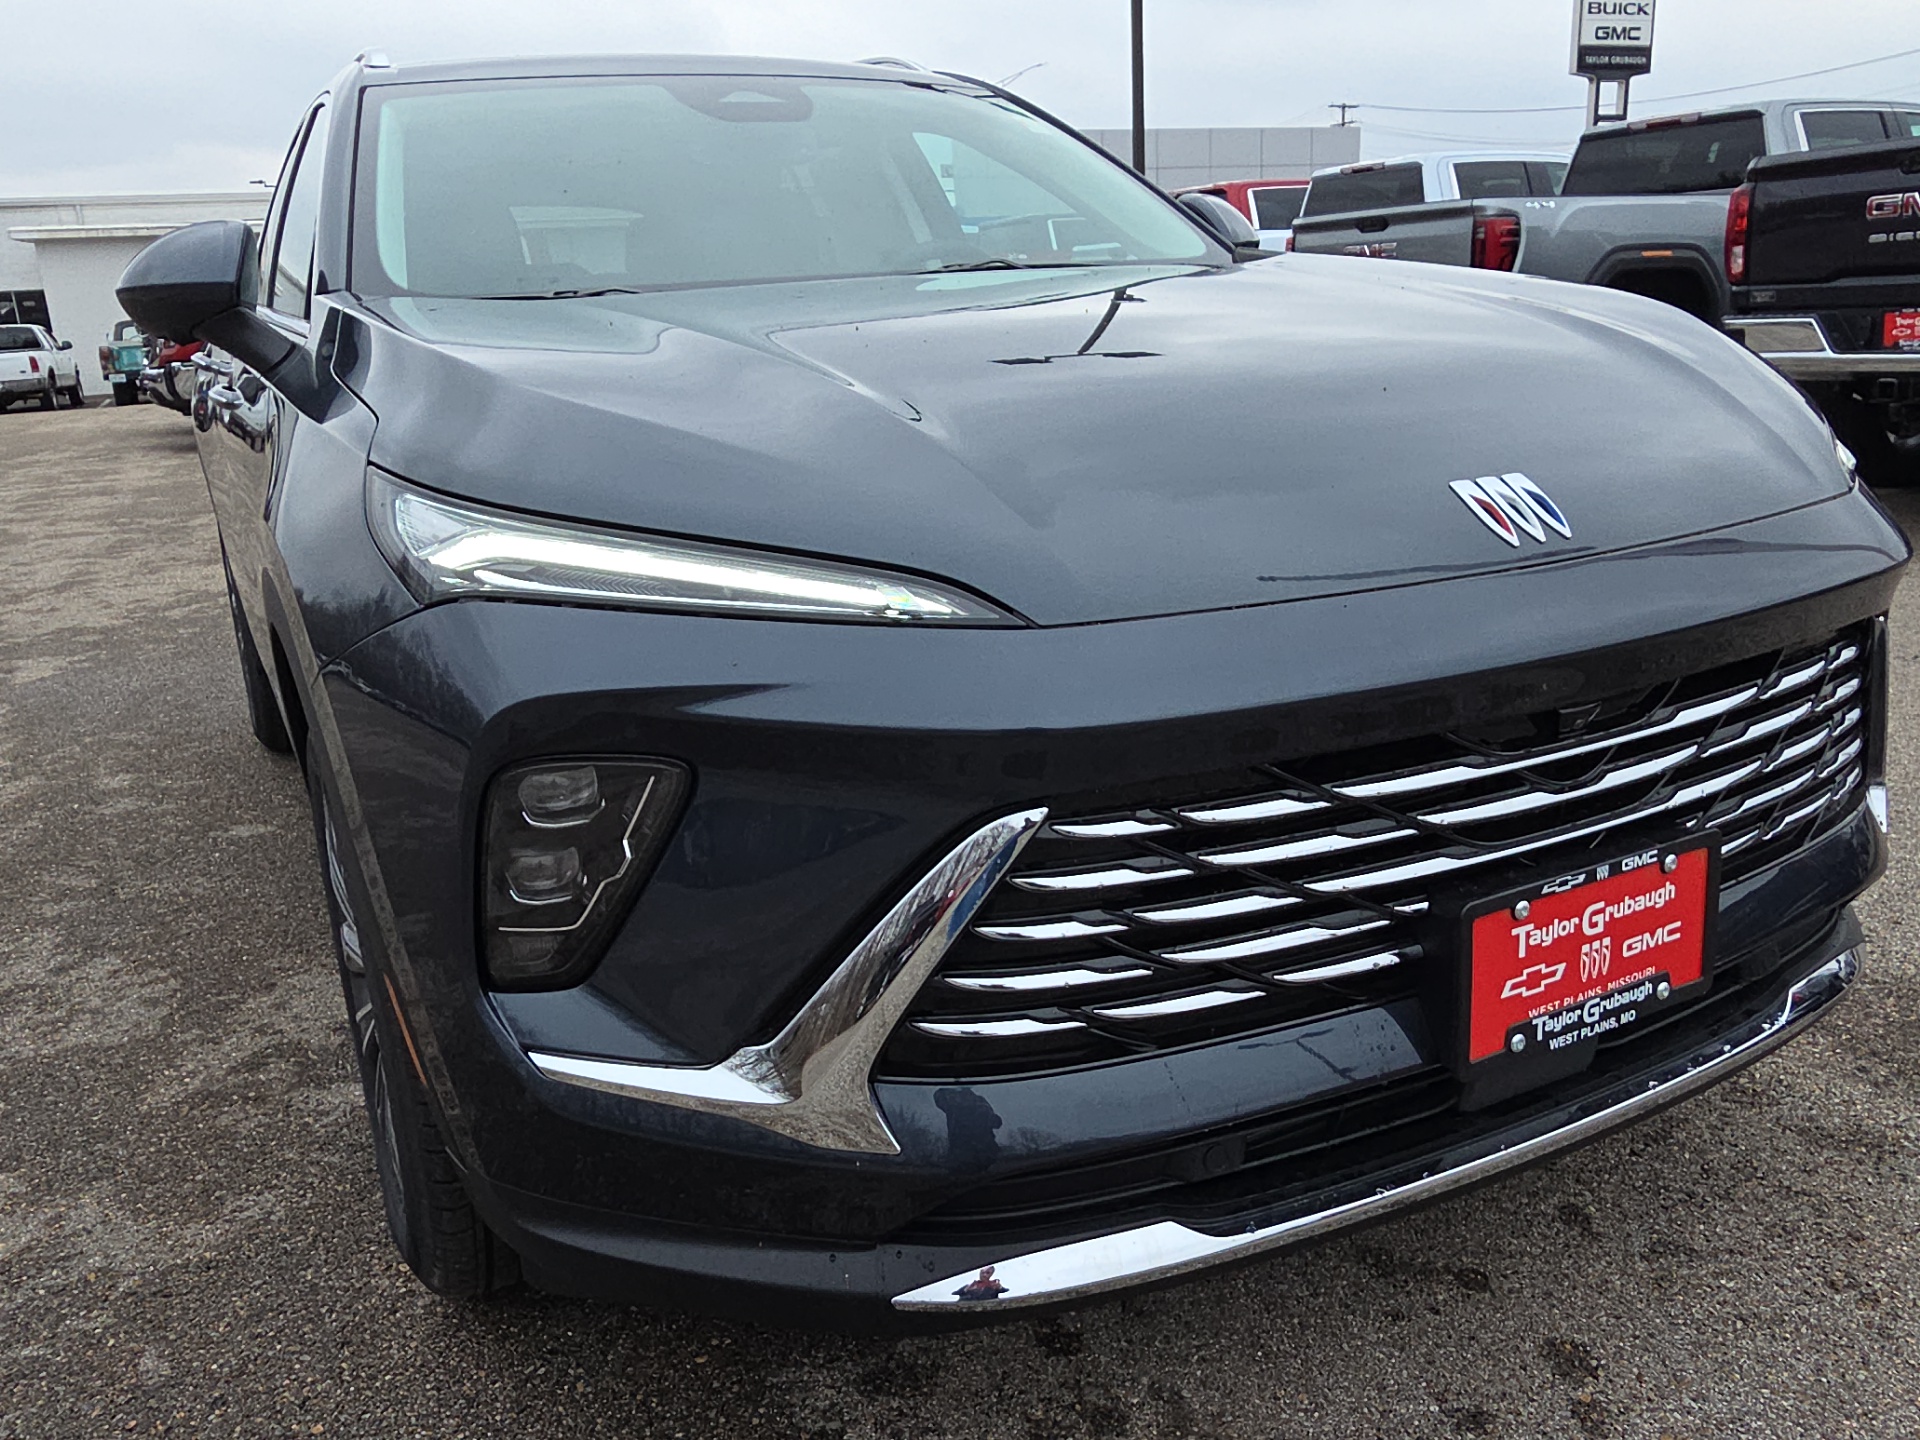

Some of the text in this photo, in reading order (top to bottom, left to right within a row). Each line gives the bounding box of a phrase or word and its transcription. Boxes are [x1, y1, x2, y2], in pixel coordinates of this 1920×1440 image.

[1587, 2, 1650, 15] BUICK
[1595, 26, 1641, 40] GMC
[1621, 850, 1658, 871] GMC
[1511, 881, 1675, 958] Taylor Grubaugh
[1622, 921, 1681, 958] GMC
[1607, 966, 1656, 991] MISSOURI
[1532, 980, 1653, 1041] Taylor Grubaugh
[1549, 1009, 1636, 1050] WEST PLAINS, MO
